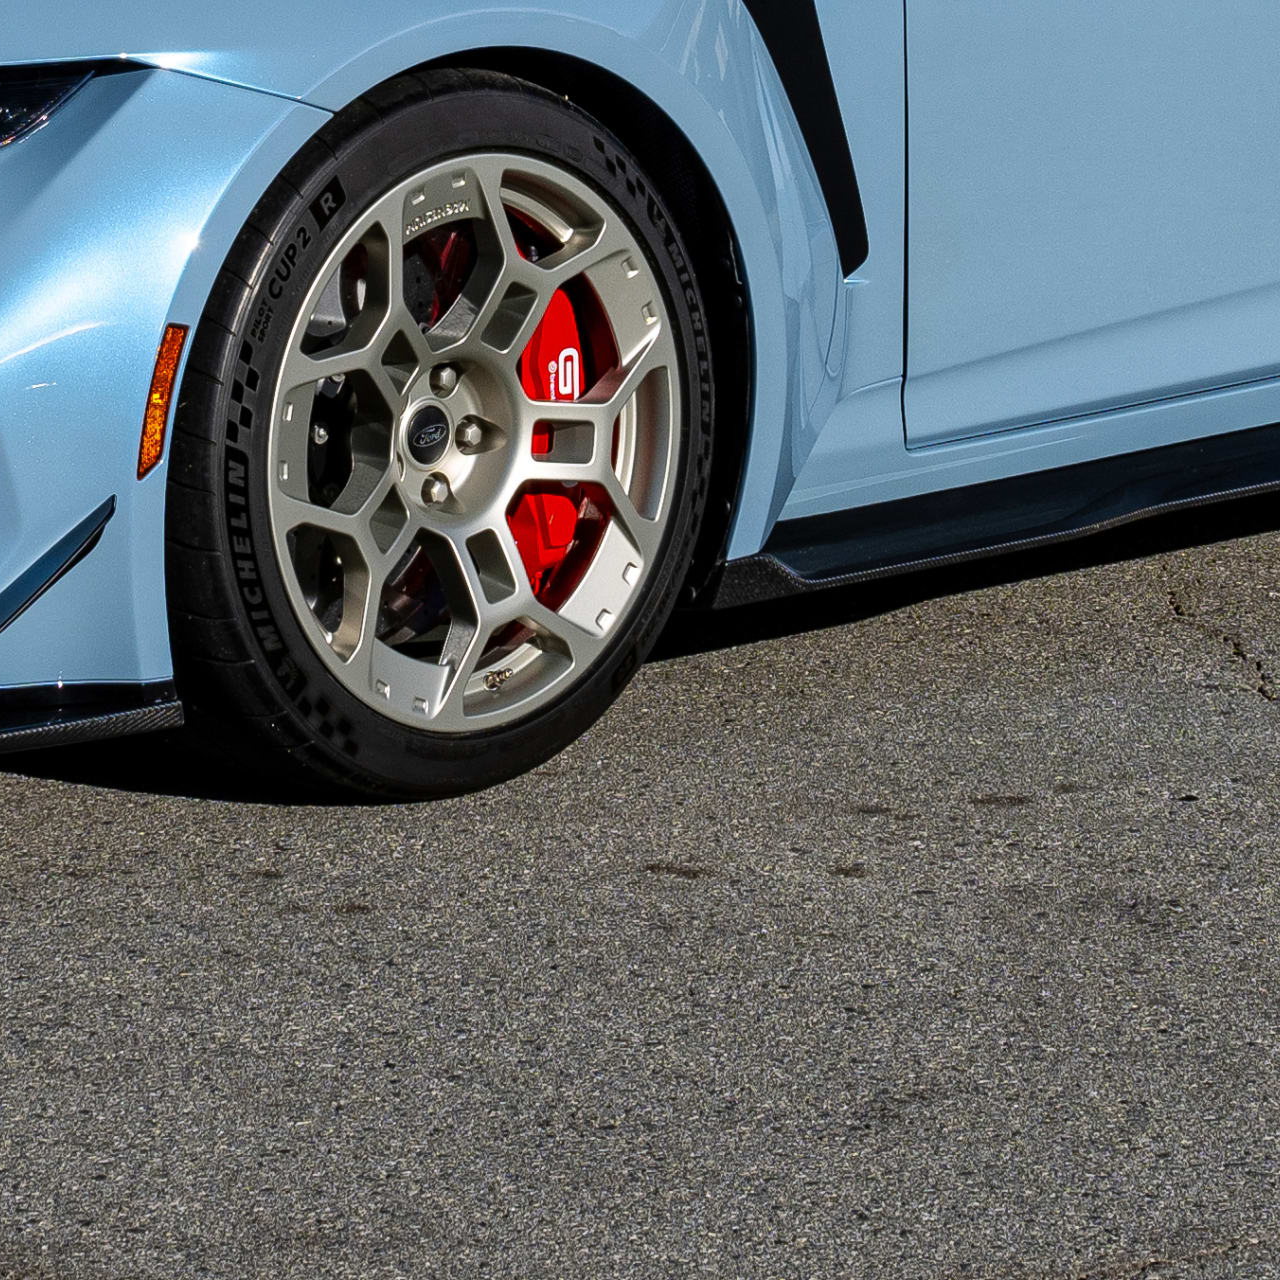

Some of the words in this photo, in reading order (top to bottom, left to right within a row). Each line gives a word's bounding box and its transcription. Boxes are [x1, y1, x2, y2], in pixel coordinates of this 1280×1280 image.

[268, 243, 297, 300] CUP
[296, 226, 312, 250] 2
[320, 191, 338, 217] R
[251, 298, 269, 338] PILOT
[257, 306, 274, 344] SPORT
[668, 241, 711, 424] MICHELIN
[418, 426, 442, 445] Ford
[227, 458, 284, 653] MICHELIN
